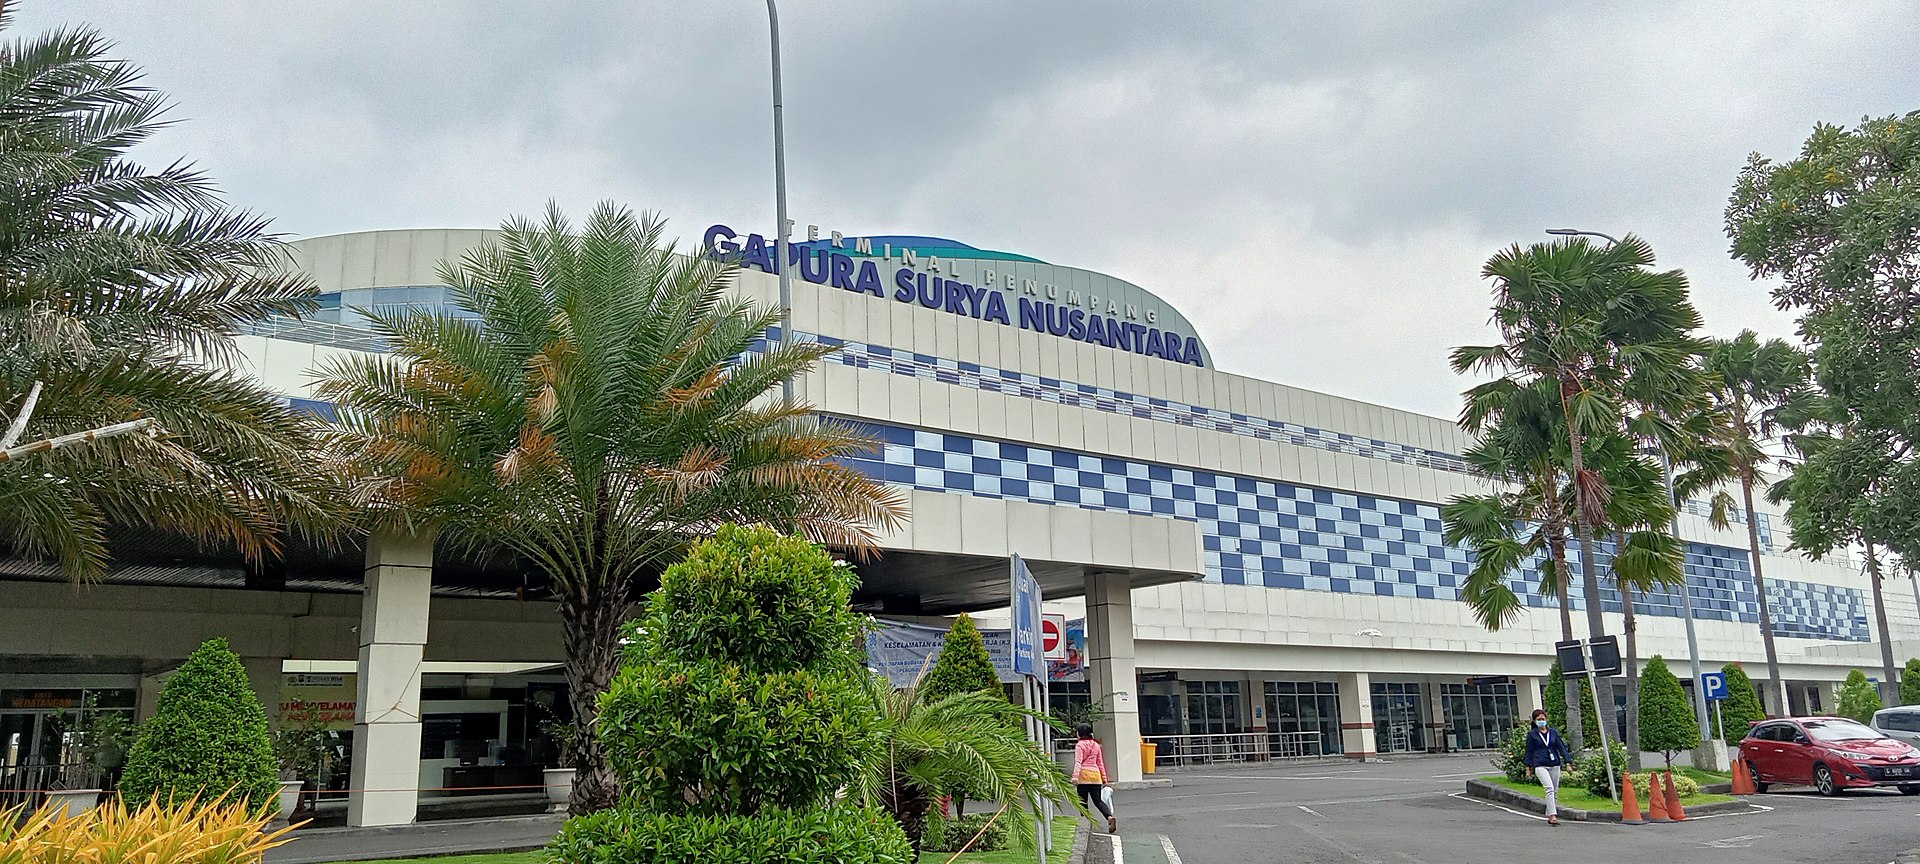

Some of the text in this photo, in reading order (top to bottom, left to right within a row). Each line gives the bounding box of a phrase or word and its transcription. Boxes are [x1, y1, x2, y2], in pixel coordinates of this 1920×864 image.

[704, 224, 1204, 367] GAPURA SURYA NUSANTARA
[785, 219, 1157, 324] TERMINAL PENUMPANG
[884, 641, 931, 649] KESELAMATAN
[1706, 675, 1722, 697] P
